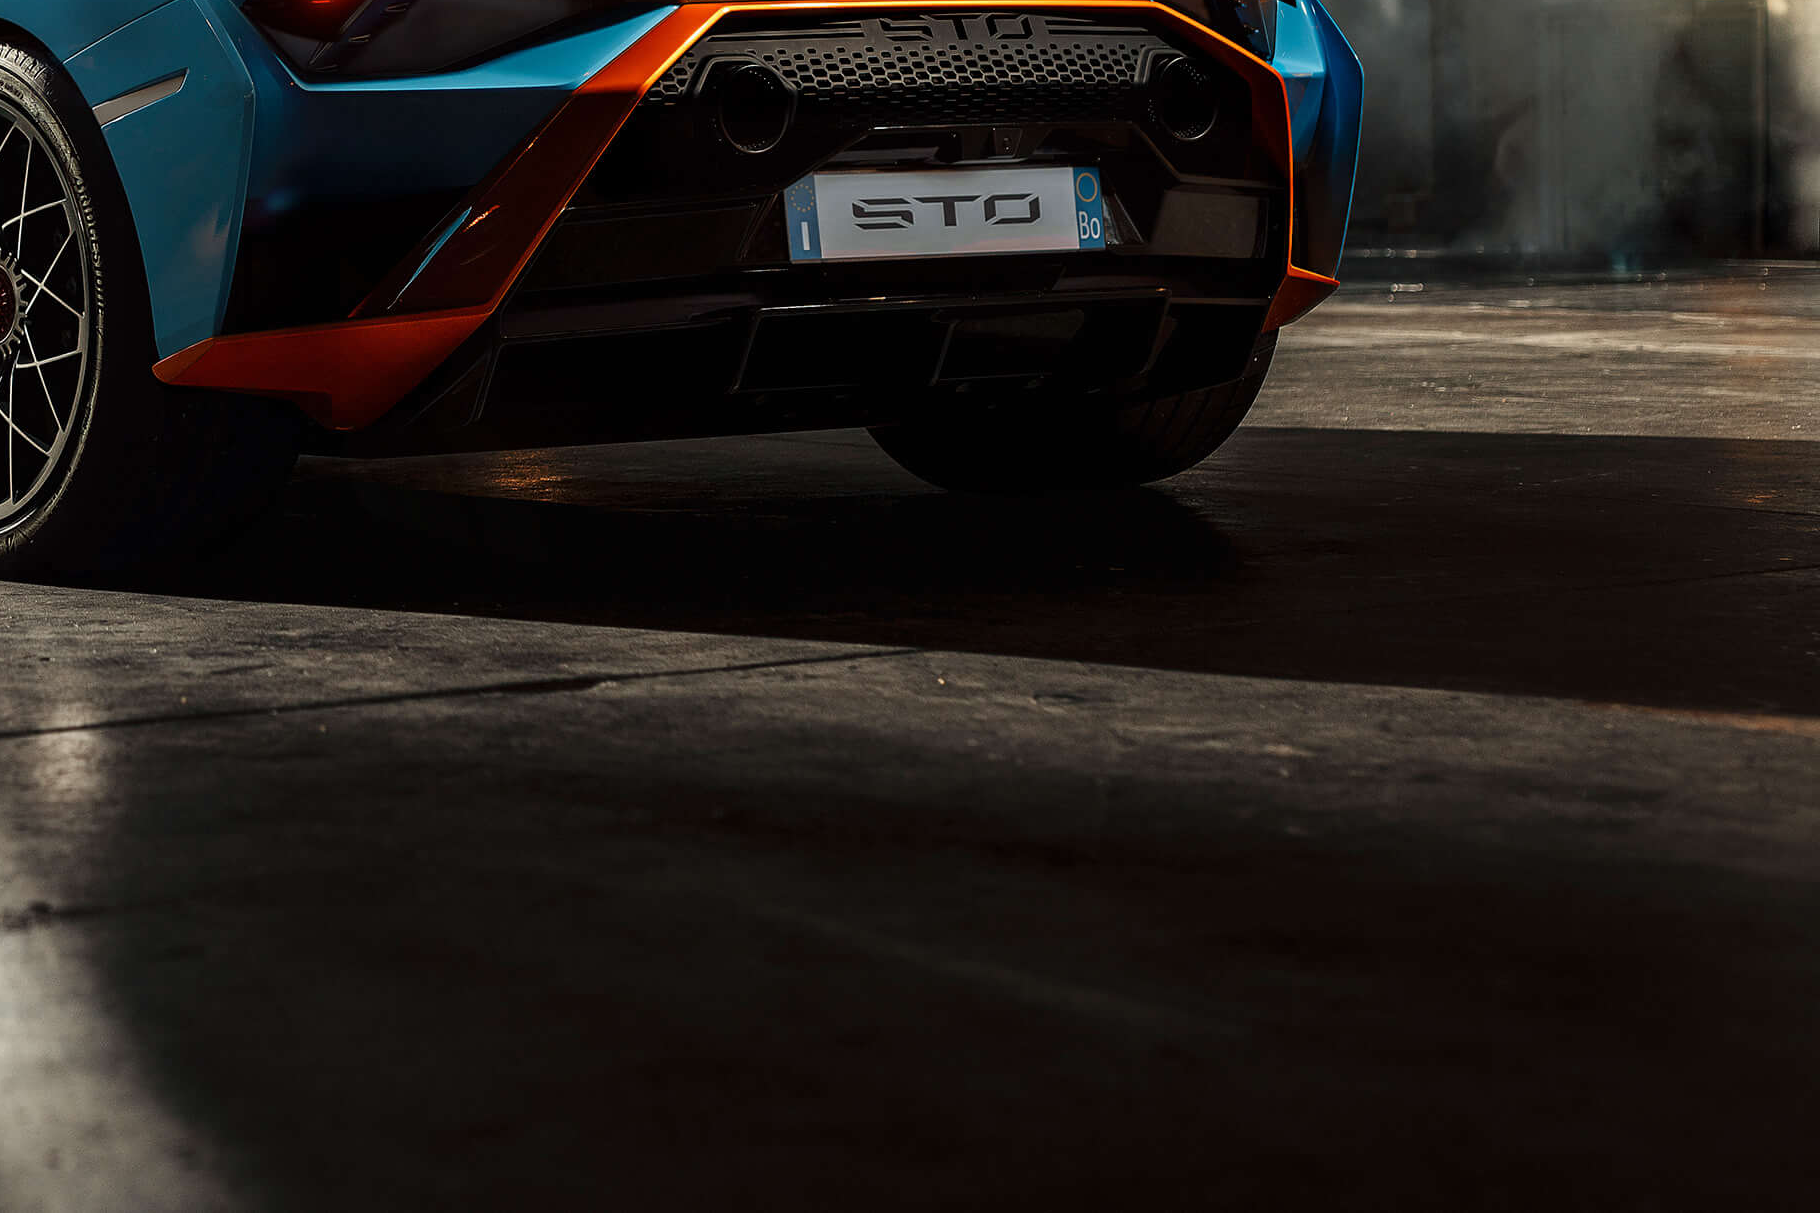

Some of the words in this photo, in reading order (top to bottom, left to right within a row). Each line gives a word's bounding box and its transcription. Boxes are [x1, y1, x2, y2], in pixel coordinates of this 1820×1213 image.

[879, 14, 1034, 42] STO
[800, 221, 811, 251] I
[852, 192, 1041, 230] STO
